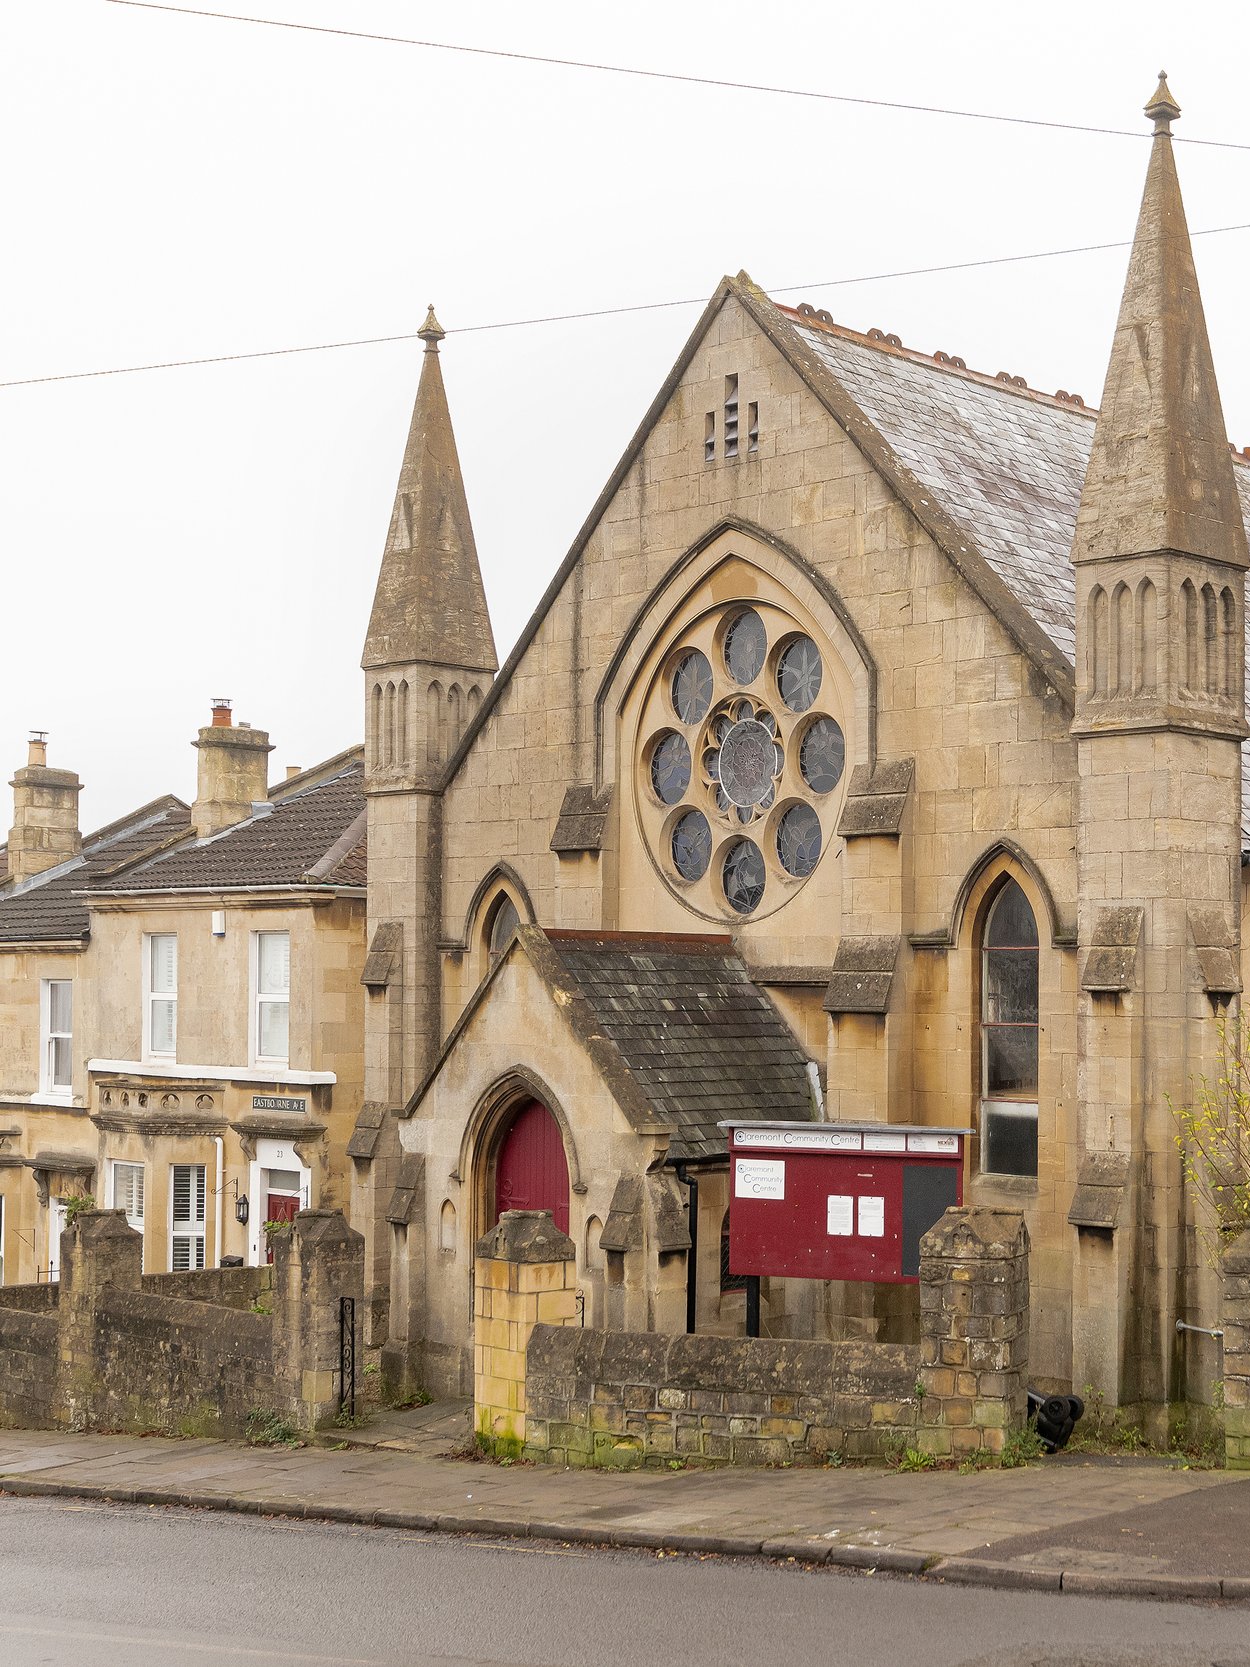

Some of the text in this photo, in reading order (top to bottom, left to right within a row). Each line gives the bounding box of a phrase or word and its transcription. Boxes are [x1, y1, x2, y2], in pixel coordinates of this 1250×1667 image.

[253, 1098, 304, 1110] EASTBORNE AE
[735, 1130, 781, 1143] Claremont
[783, 1132, 829, 1144] Community
[830, 1134, 860, 1146] Centre
[277, 1150, 283, 1158] 23
[737, 1163, 774, 1174] Claremont
[743, 1173, 784, 1184] Community
[752, 1183, 777, 1193] Centre
